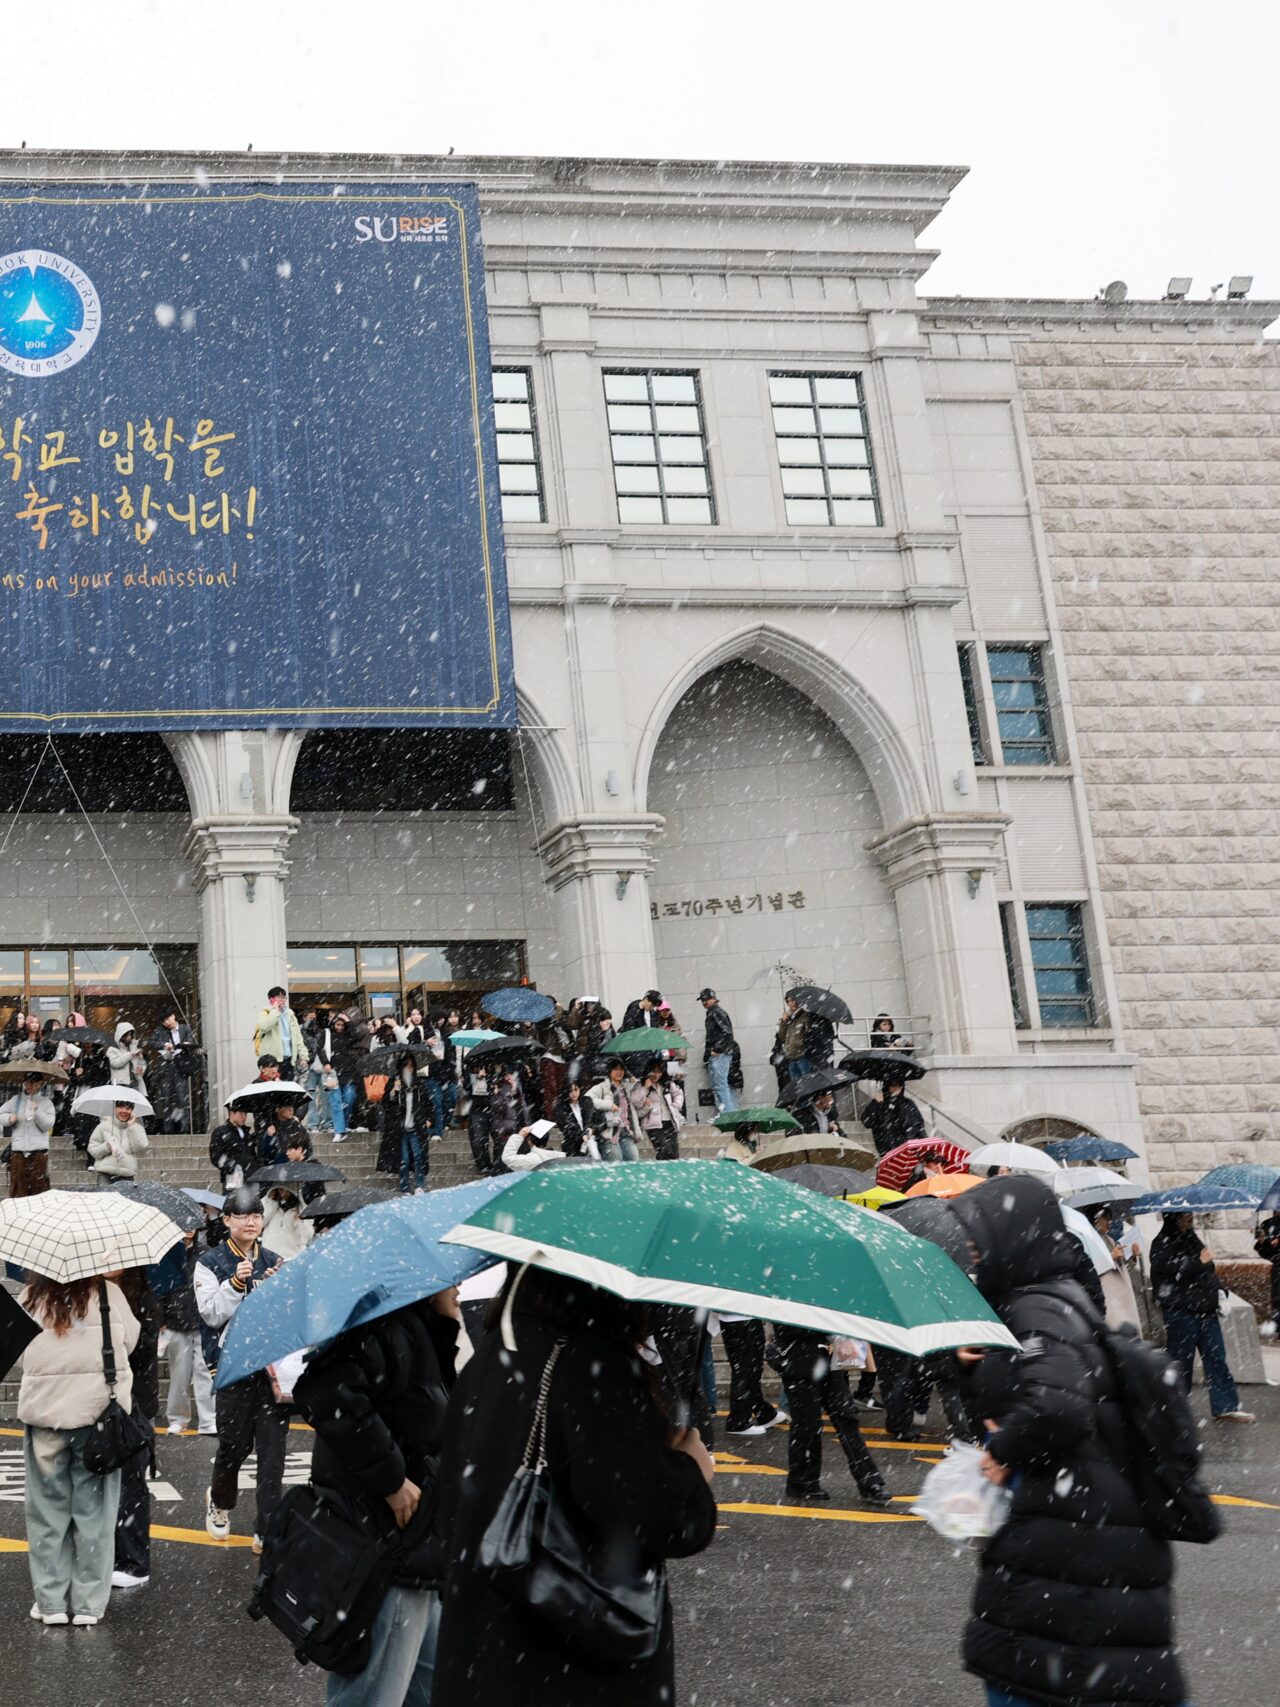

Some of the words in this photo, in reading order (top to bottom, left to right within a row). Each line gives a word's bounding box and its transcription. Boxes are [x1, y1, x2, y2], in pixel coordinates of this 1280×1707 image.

[354, 216, 397, 242] SU
[399, 216, 448, 234] RISE
[38, 254, 97, 335] UNIVERSITY
[25, 341, 47, 349] 1906
[99, 417, 236, 481] 입학을
[16, 484, 256, 550] 축하합니다!
[36, 575, 59, 592] on
[63, 571, 113, 597] your
[124, 562, 238, 588] admission!
